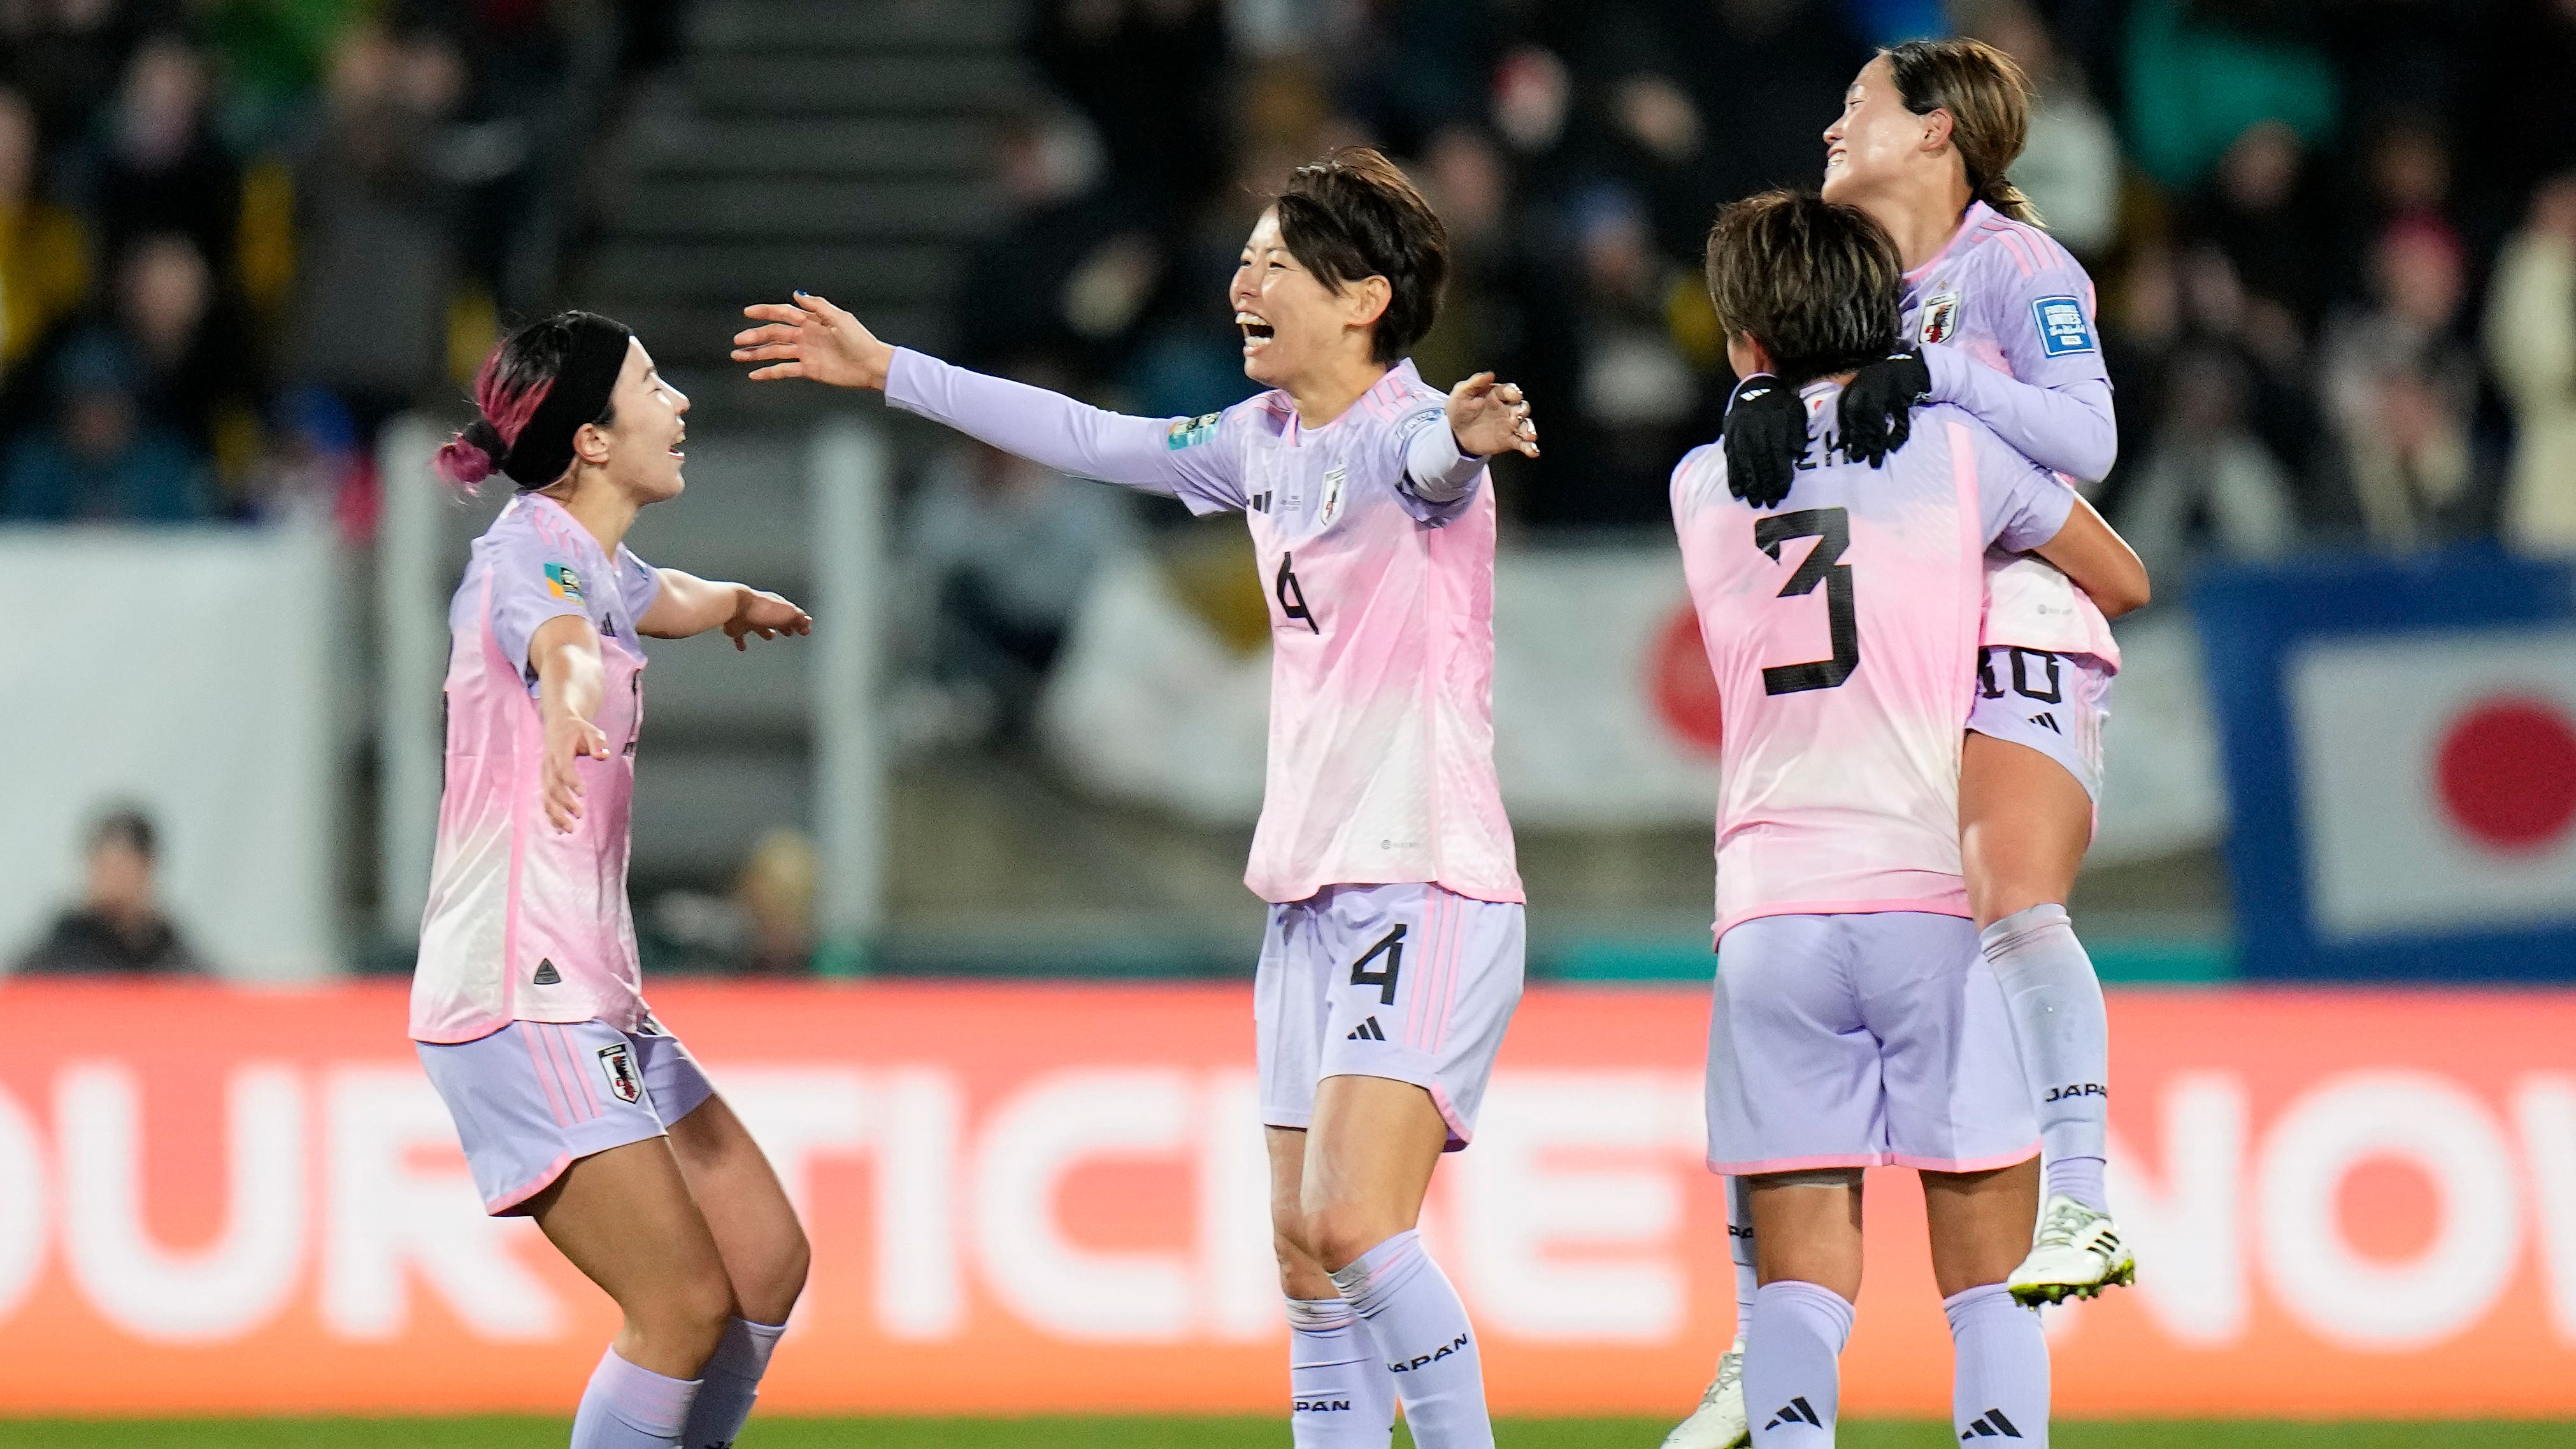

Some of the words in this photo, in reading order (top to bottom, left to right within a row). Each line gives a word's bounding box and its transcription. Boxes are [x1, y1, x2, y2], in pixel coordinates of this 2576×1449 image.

[1277, 552, 1319, 635] 4
[1755, 507, 1859, 696] 3
[1979, 646, 2062, 704] 10
[1350, 924, 1407, 1005] 4
[2041, 1065, 2576, 1345] NO
